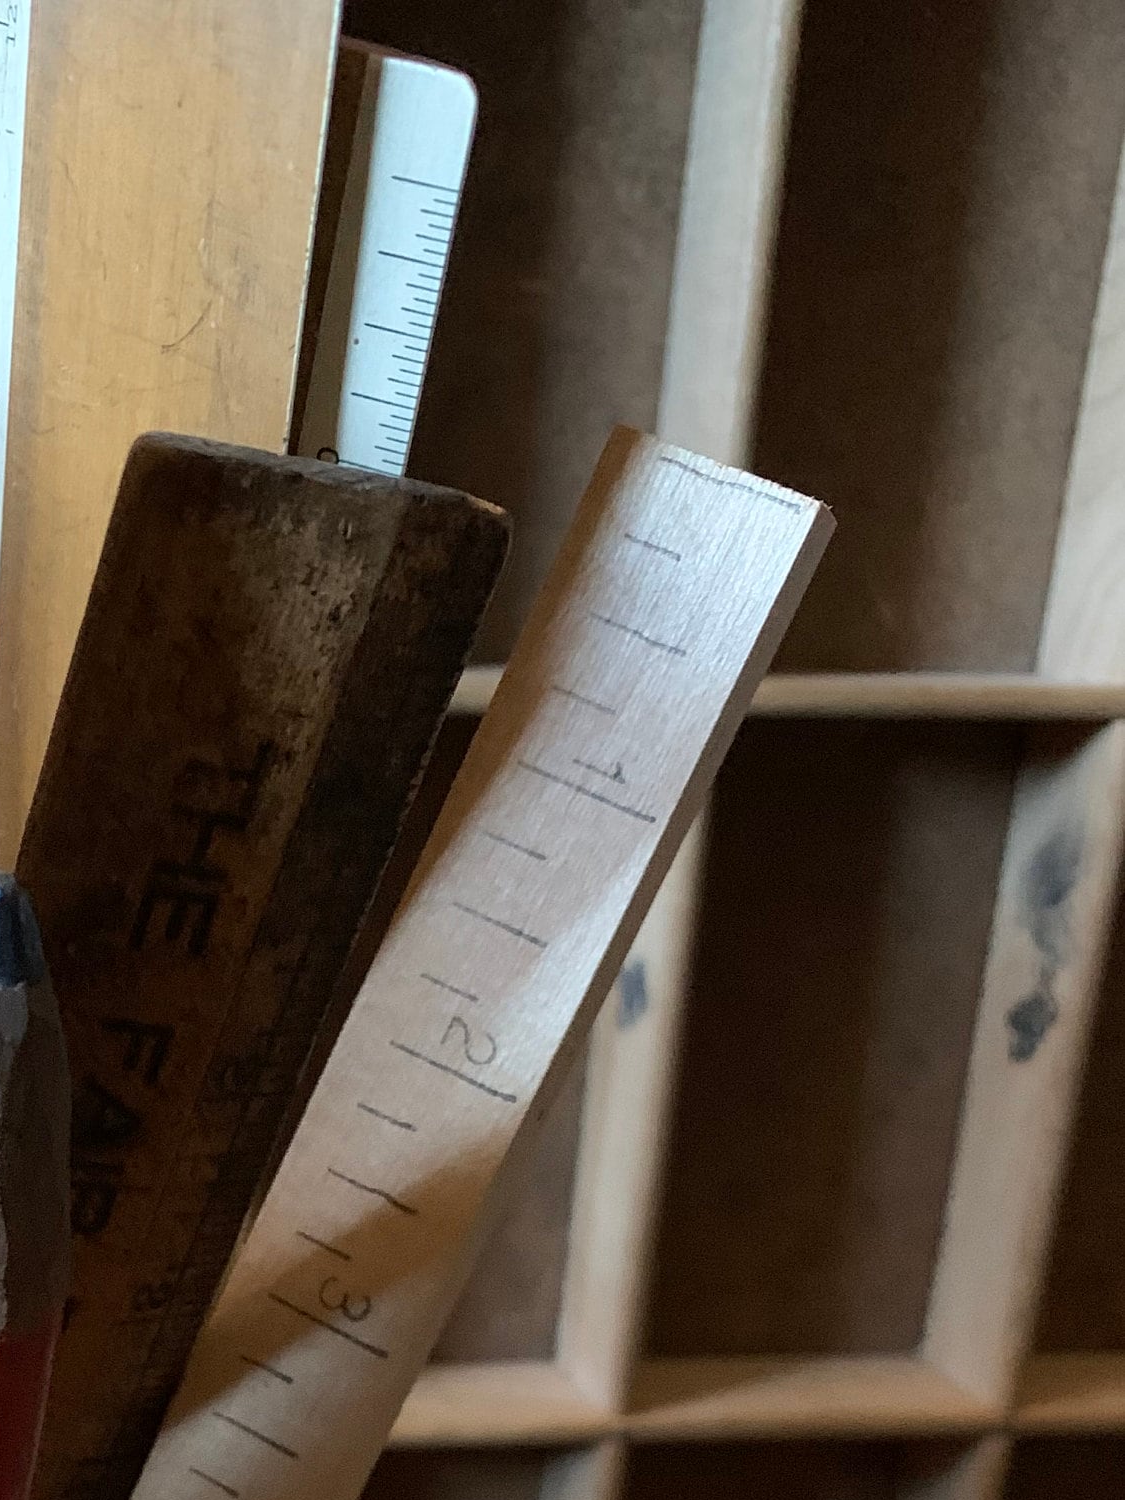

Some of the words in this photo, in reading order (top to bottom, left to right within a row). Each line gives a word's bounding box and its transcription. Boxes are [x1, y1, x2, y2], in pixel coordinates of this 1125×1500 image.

[572, 758, 628, 785] 1
[129, 739, 278, 962] THE
[440, 1015, 498, 1067] 2
[318, 1274, 372, 1324] 3
